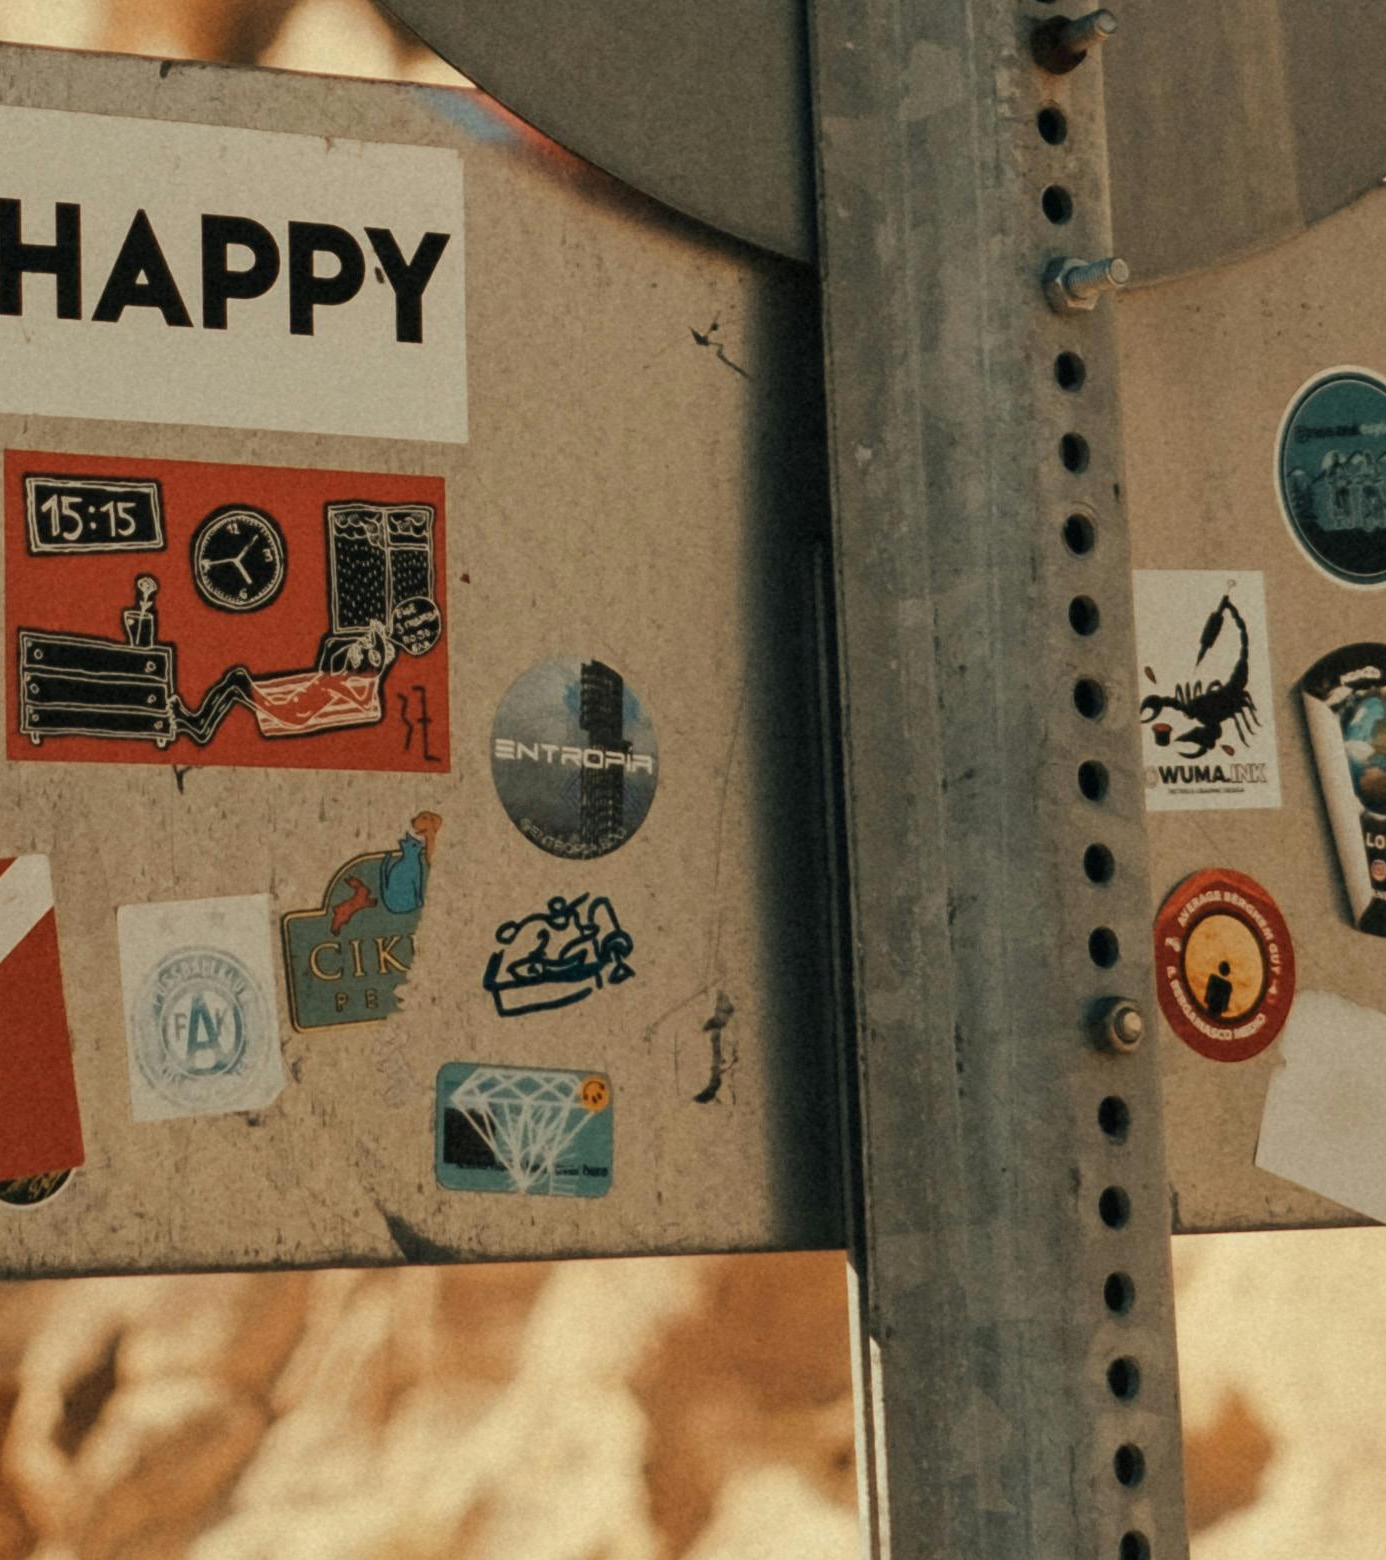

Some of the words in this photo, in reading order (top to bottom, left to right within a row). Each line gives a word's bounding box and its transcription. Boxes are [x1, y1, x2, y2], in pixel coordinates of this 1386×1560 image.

[41, 495, 137, 540] 15:15
[494, 738, 653, 775] ENTROPIA
[1178, 890, 1222, 928] AVERAGE
[1268, 942, 1282, 975] GUY
[309, 934, 415, 981] CIK
[335, 988, 379, 1013] PE
